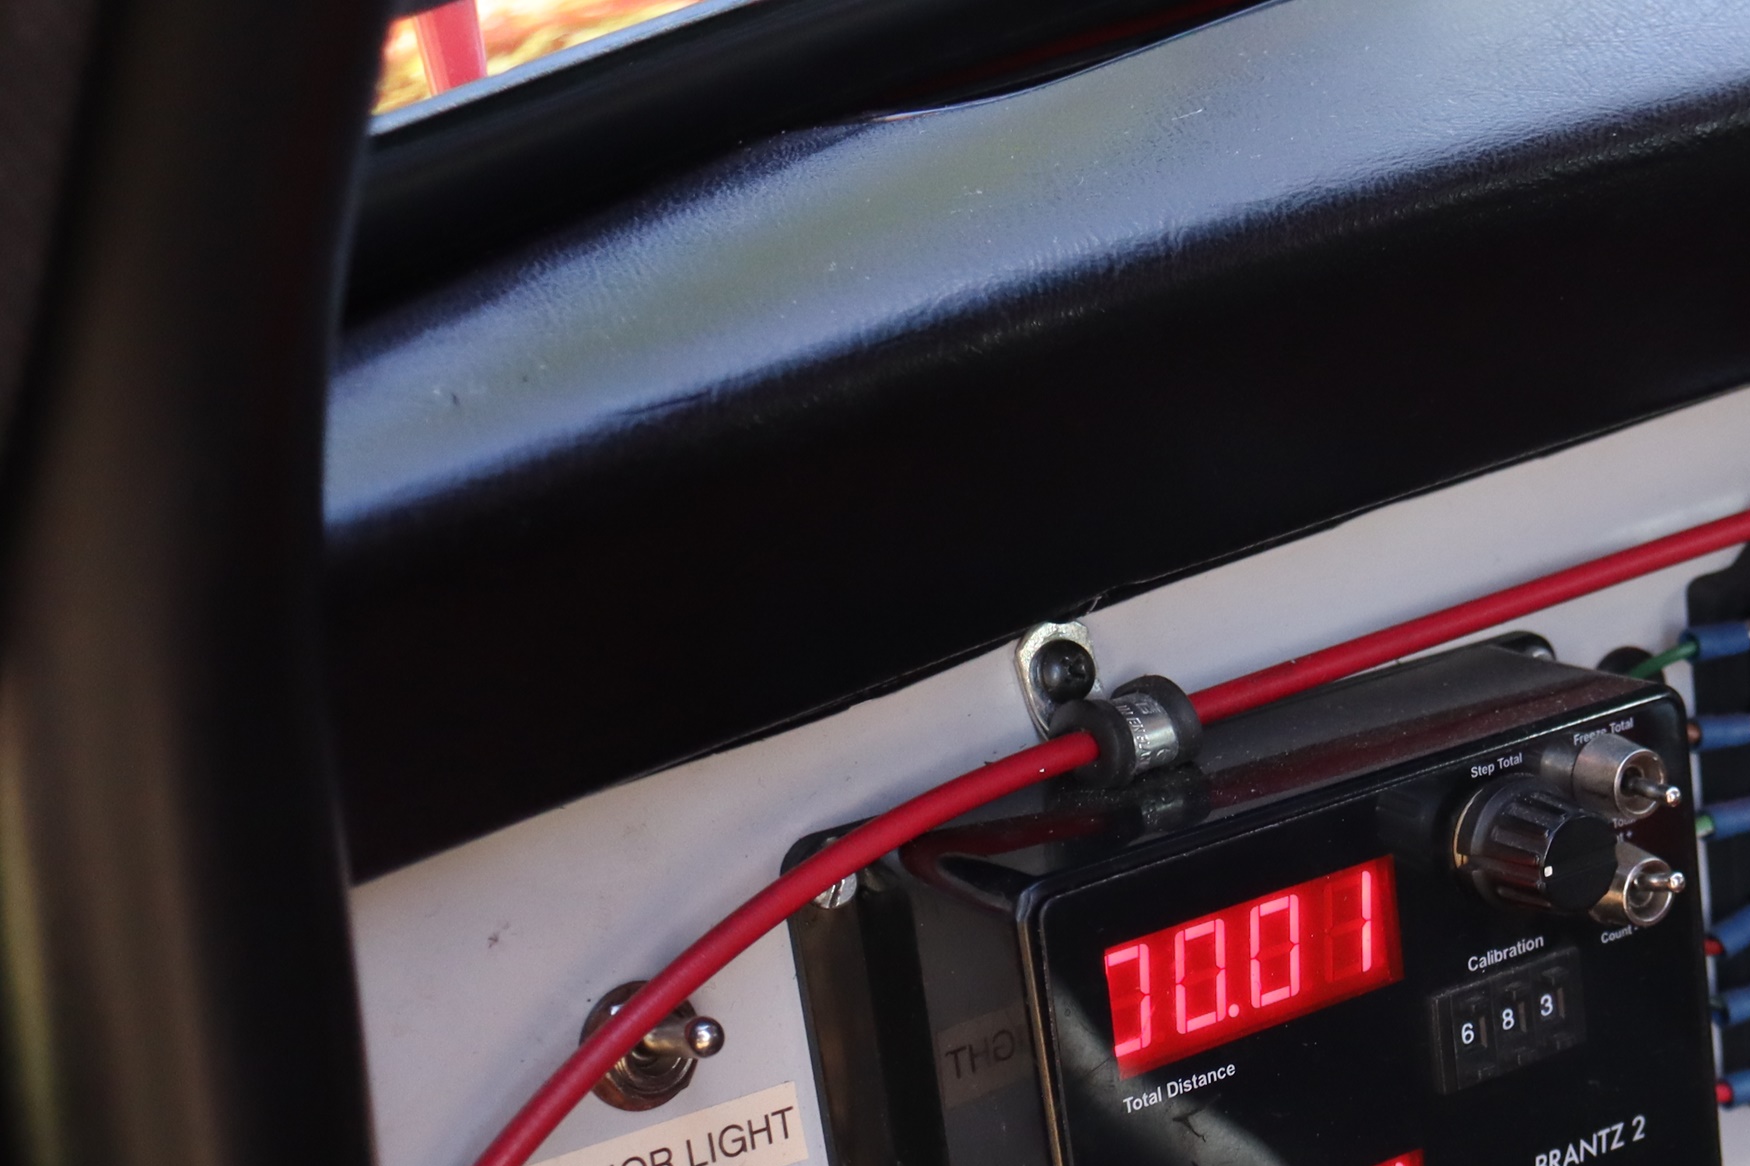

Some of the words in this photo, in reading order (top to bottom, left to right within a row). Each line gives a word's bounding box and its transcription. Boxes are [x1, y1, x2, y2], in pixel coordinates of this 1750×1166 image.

[1609, 716, 1635, 735] Total
[1470, 763, 1496, 779] Step
[1496, 752, 1524, 770] Total
[1600, 924, 1633, 944] Count
[1467, 936, 1545, 972] Calibration
[1122, 1086, 1163, 1114] Total
[1166, 1063, 1237, 1099] Distance
[1631, 1114, 1646, 1142] 2
